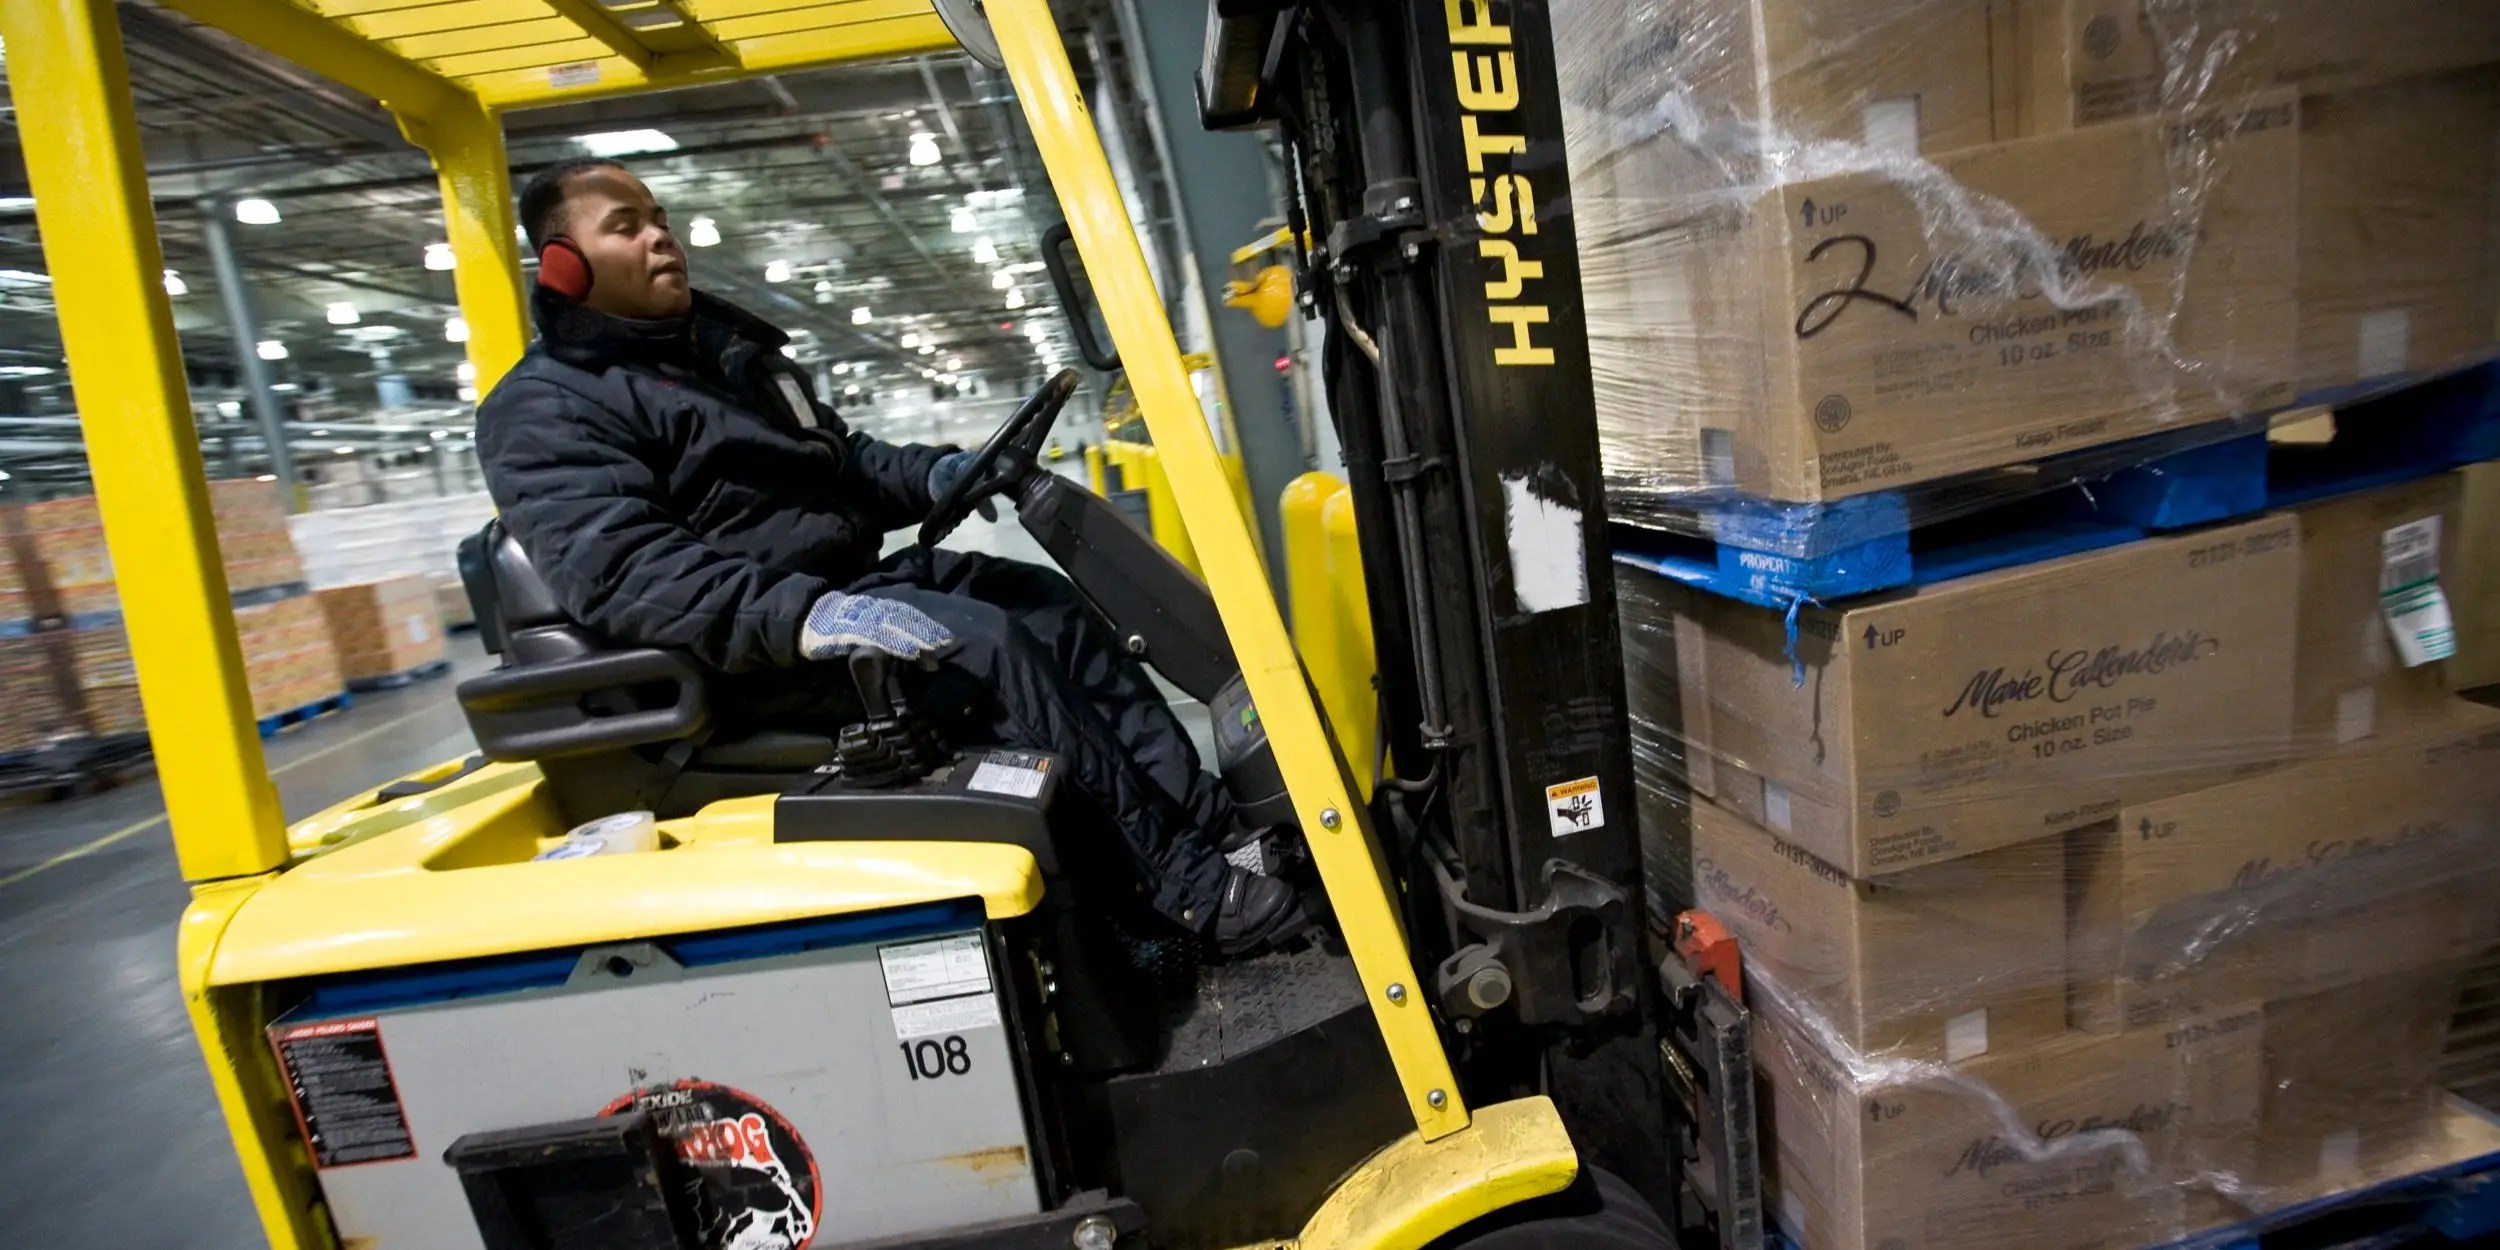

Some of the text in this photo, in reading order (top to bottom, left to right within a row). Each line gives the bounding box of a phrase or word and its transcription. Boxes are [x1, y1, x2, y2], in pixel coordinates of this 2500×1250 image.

[1444, 0, 1554, 365] HYSTER
[1821, 206, 1847, 225] UP
[1796, 234, 1918, 338] 2
[1969, 315, 2056, 345] Chicken
[2000, 345, 2024, 366] 10
[2066, 331, 2111, 351] Size
[1881, 629, 1905, 648] UP
[1942, 628, 2219, 718] Marie Callender's
[2007, 696, 2158, 744] Chicken Pot Pie
[2032, 741, 2055, 760] 10
[2093, 724, 2134, 746] Size
[1560, 781, 1596, 796] WARNING
[2154, 821, 2177, 839] UP
[900, 1035, 971, 1080] 108
[1884, 1104, 1906, 1120] UP
